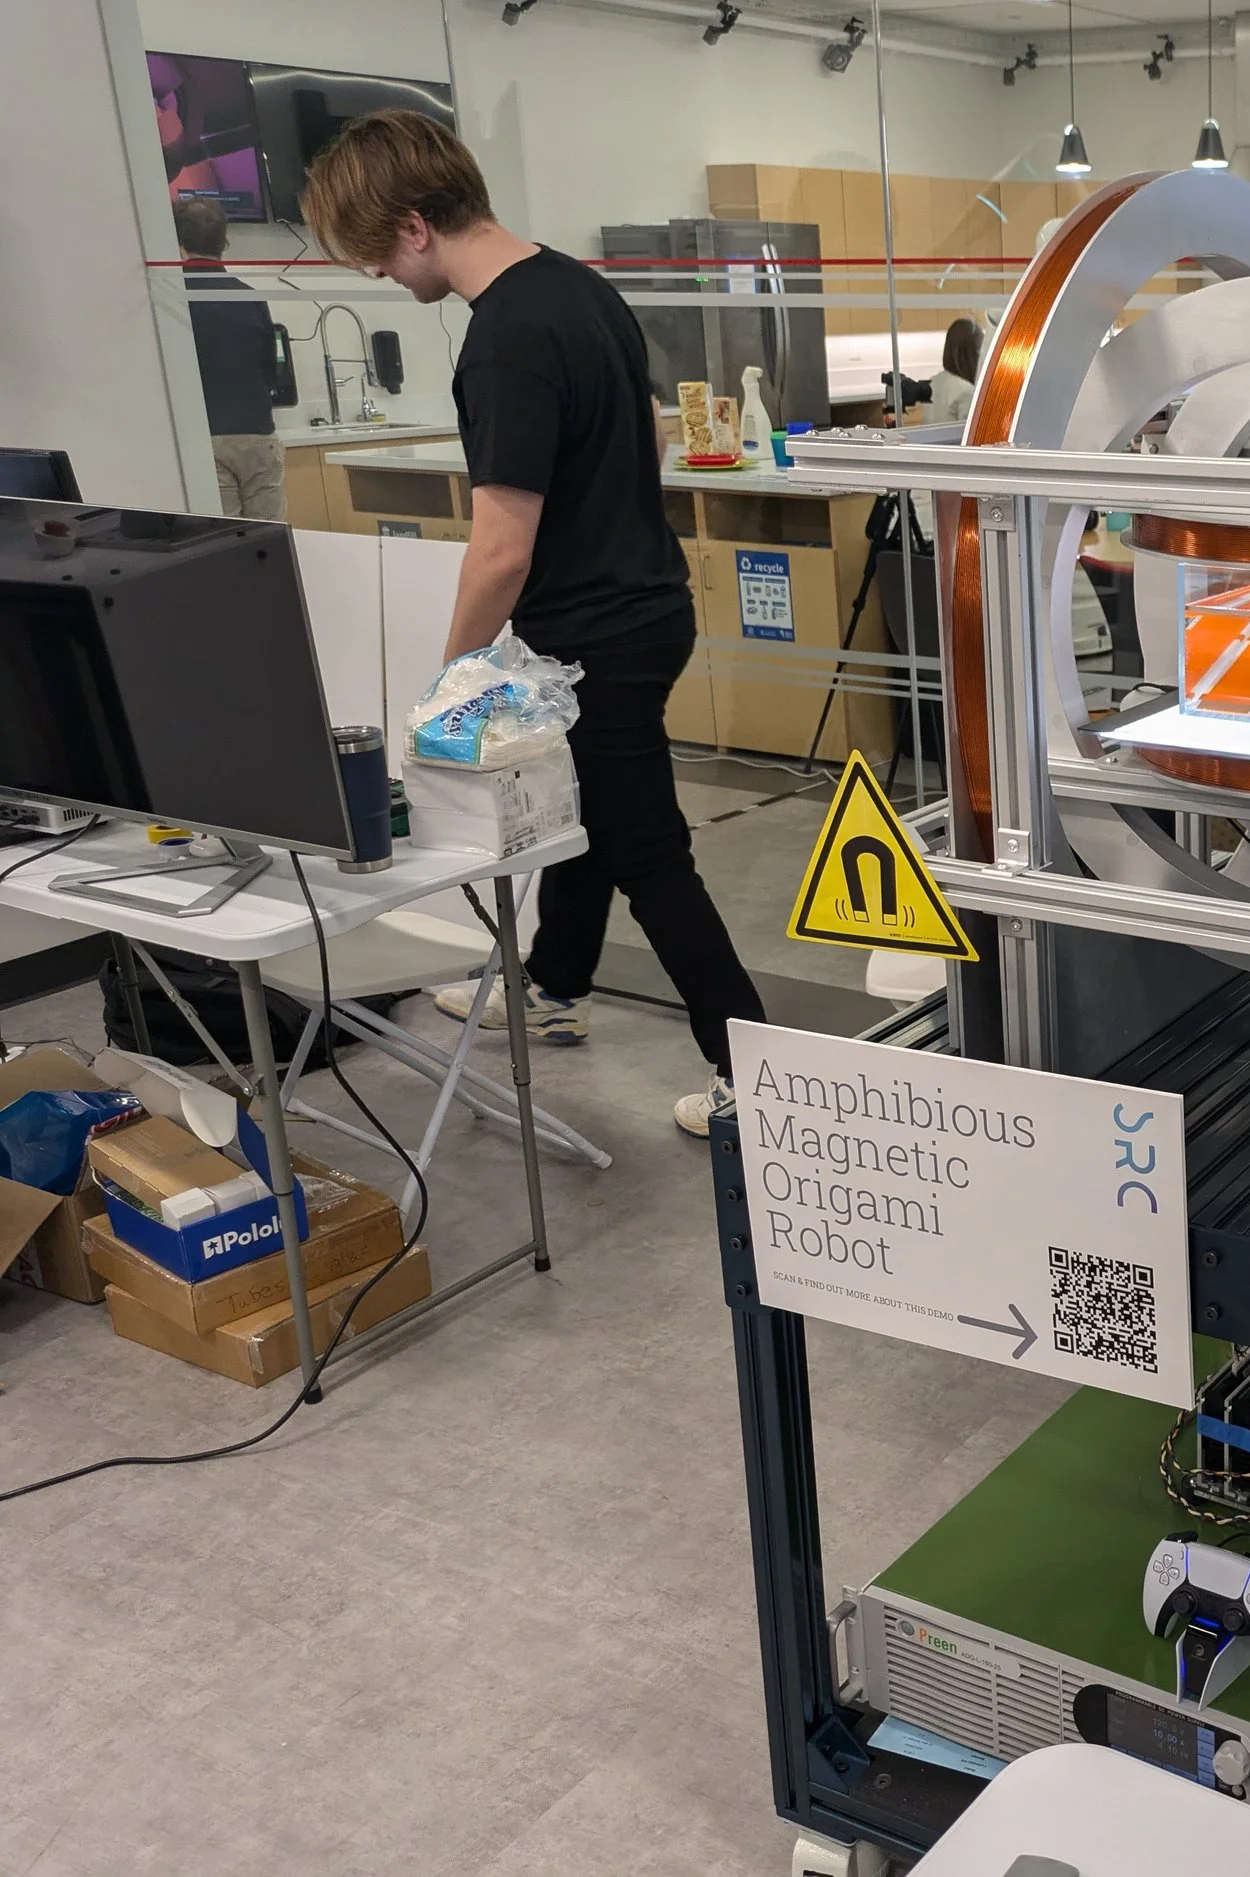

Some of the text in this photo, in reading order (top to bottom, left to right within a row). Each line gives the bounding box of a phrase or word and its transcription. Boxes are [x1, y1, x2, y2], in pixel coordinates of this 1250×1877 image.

[755, 563, 784, 574] recycle
[752, 1057, 1037, 1149] Amphibious
[754, 1107, 970, 1189] Magnetic
[1113, 1103, 1158, 1214] SRC
[762, 1161, 944, 1237] Origami
[223, 1215, 283, 1252] Polol
[766, 1209, 894, 1275] Robot
[216, 1280, 285, 1314] Tubes
[773, 1271, 954, 1322] SCAN & FIND OUT MORE ABOUT THIS DEMO
[918, 1628, 958, 1654] Preen
[1115, 1690, 1157, 1710] PROGRAMMABLE
[1167, 1709, 1186, 1721] POWER
[1187, 1716, 1206, 1727] SUPPLY
